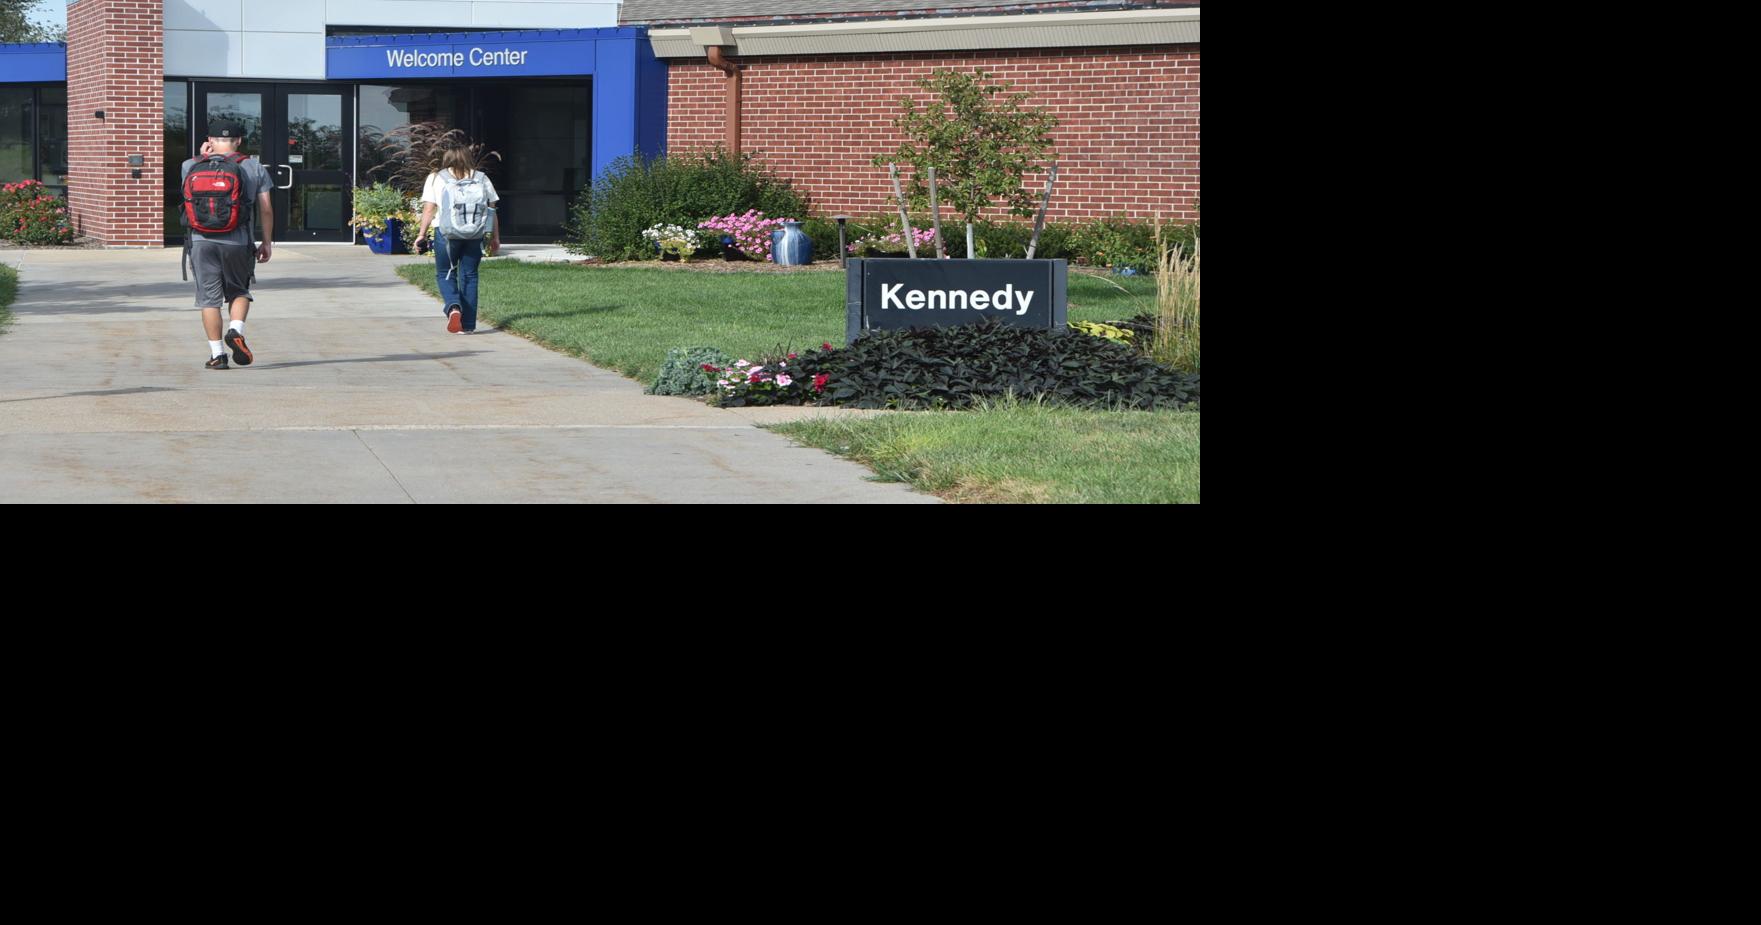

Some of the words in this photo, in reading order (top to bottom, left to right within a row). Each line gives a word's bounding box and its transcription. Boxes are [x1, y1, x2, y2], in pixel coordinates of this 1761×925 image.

[386, 49, 464, 67] Welcome
[469, 47, 528, 66] Center
[881, 283, 1034, 316] Kennedy
